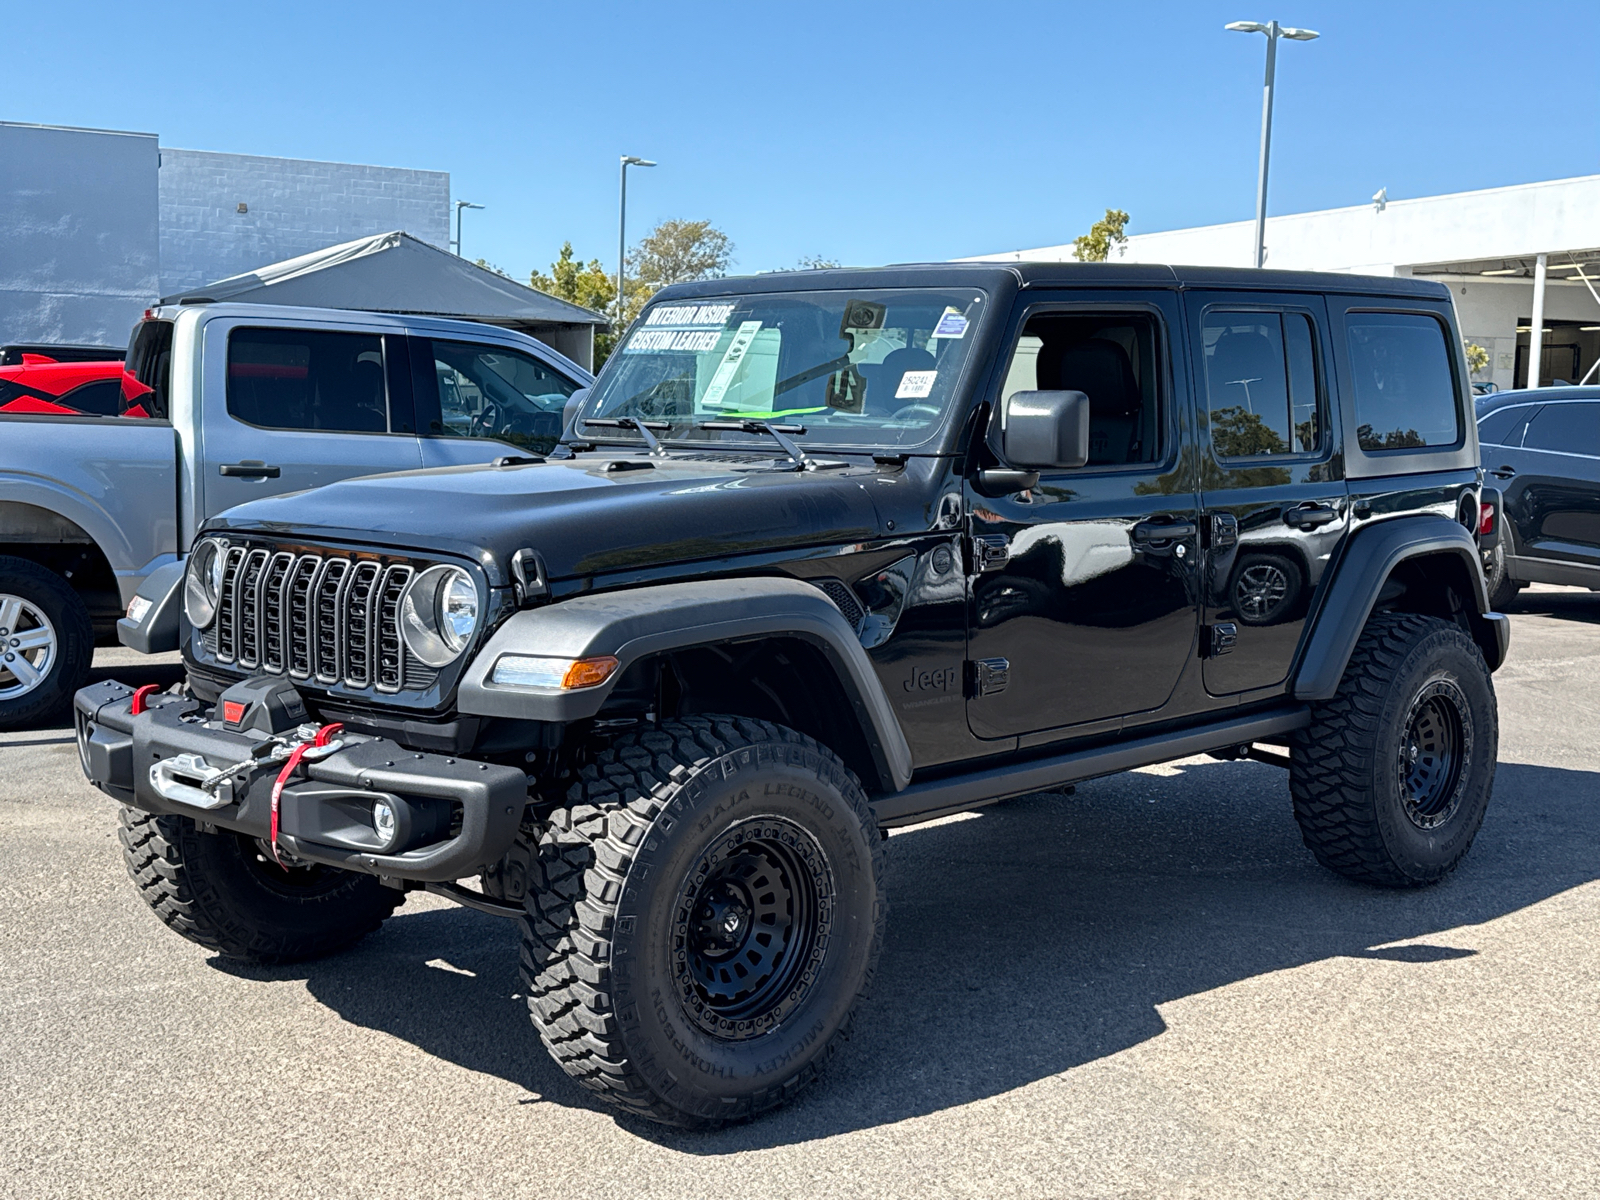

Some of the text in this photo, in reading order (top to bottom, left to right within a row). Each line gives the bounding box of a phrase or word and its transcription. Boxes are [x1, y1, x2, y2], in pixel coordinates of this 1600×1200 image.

[645, 305, 735, 325] INTERIOR INSIDE
[628, 331, 722, 351] CUSTOM LEATHER
[903, 666, 955, 692] Jeep
[698, 788, 751, 833] BAJA
[763, 782, 836, 822] LEGEND
[651, 988, 827, 1080] MICKEY THOMPSON
